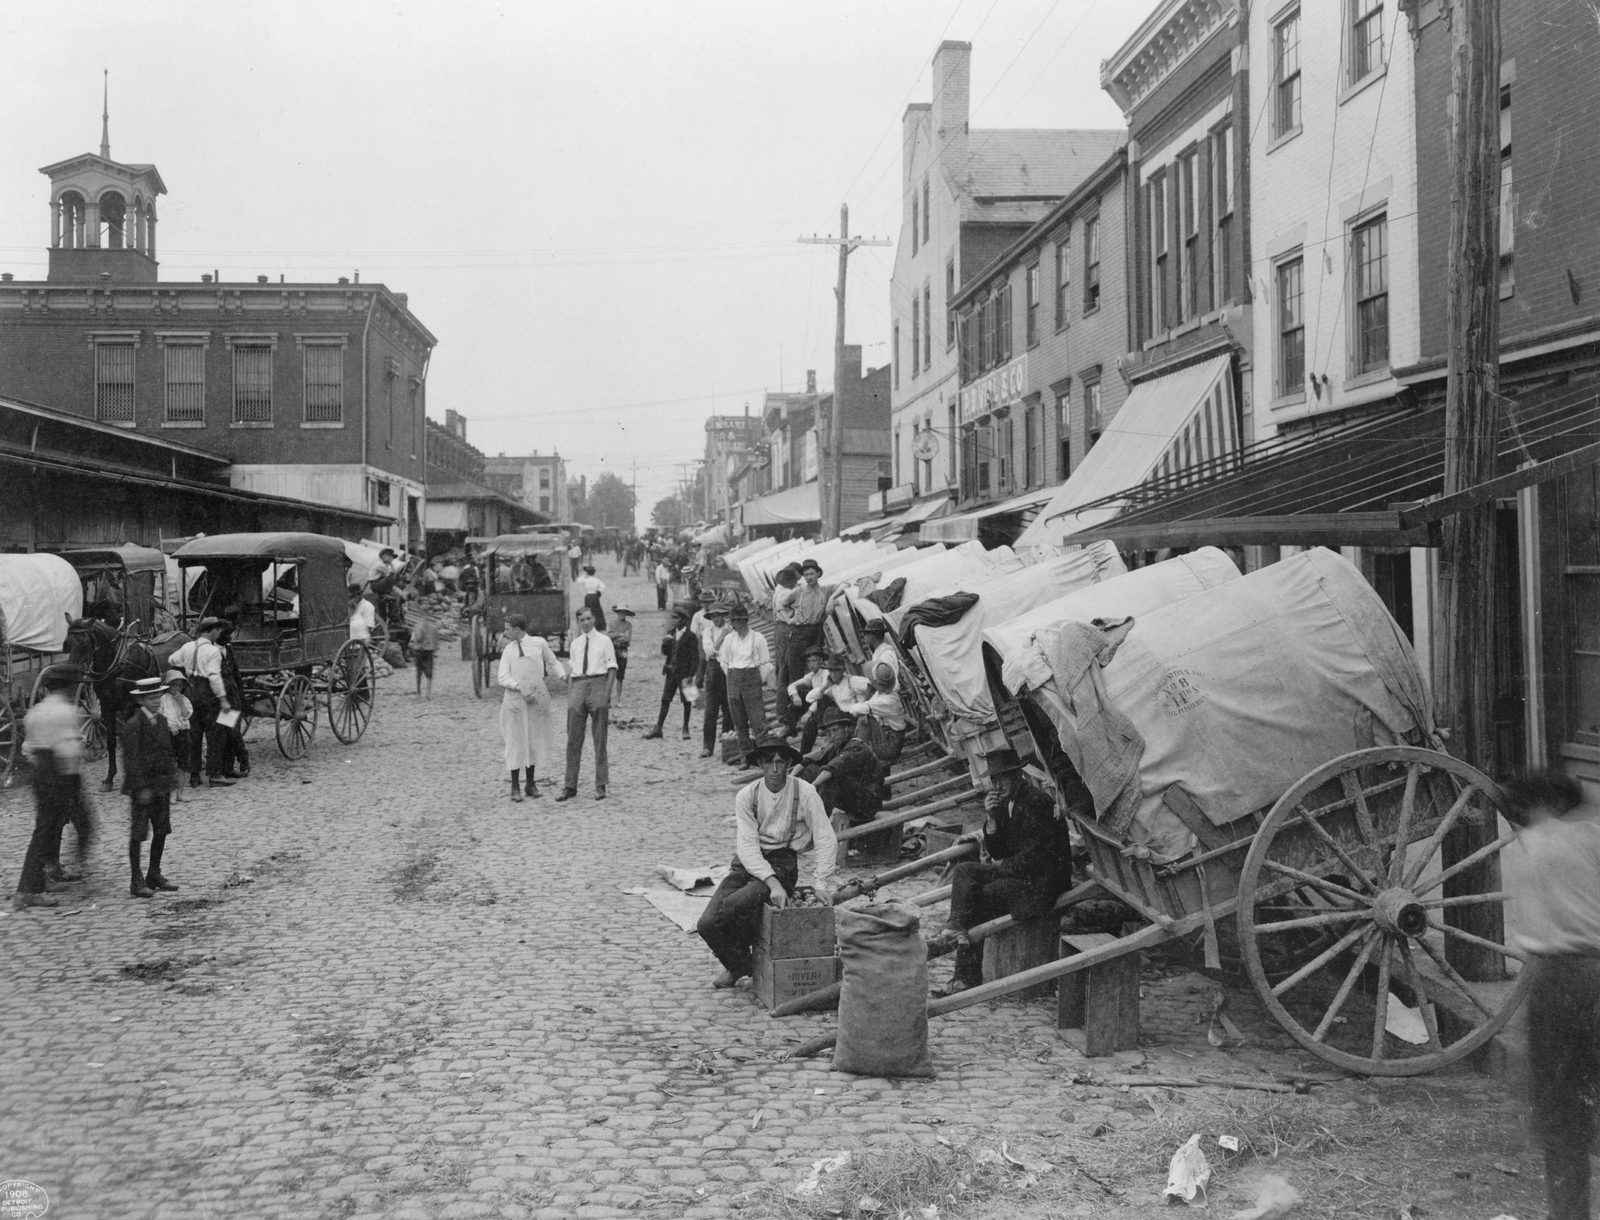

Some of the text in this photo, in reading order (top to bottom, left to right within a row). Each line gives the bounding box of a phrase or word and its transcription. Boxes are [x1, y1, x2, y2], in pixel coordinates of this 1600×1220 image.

[1010, 363, 1023, 395] CO
[1178, 677, 1190, 688] 8
[791, 972, 817, 981] RIVER
